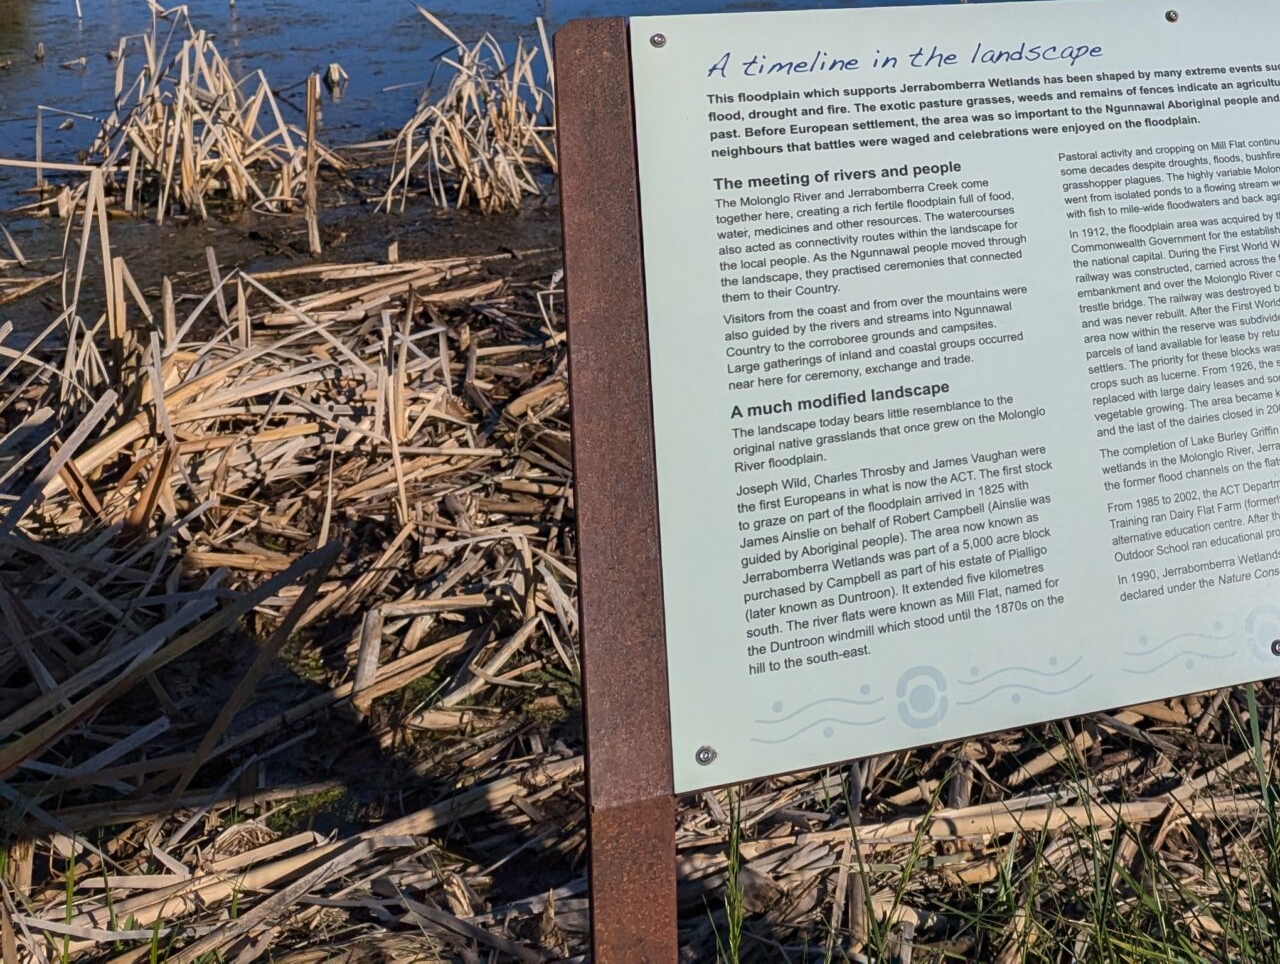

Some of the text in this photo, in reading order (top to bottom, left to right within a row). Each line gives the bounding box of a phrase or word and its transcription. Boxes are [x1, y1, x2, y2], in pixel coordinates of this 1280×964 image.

[706, 41, 1104, 79] A timeline in the landscape
[706, 93, 735, 104] This
[737, 89, 800, 103] floodplain
[803, 87, 840, 99] which
[843, 85, 897, 98] supports
[900, 80, 987, 94] Jerrabomberra
[987, 75, 1041, 88] Wetlands
[1042, 74, 1064, 85] has
[1065, 73, 1094, 84] been
[1095, 69, 1136, 83] shaped
[1137, 69, 1151, 81] by
[1153, 69, 1183, 79] many
[1184, 66, 1227, 77] extreme
[1228, 63, 1264, 74] events
[711, 115, 1201, 159] neighbours that battles were waged and celebrations were enjoyed on the floodplain.
[712, 161, 962, 190] The meeting of rivers and people
[1063, 194, 1088, 205] went
[1089, 193, 1112, 203] from
[1114, 188, 1151, 201] isolated
[1153, 186, 1183, 200] ponds
[1183, 186, 1194, 195] to
[1195, 186, 1203, 194] a
[1203, 182, 1237, 193] flowing
[1238, 180, 1270, 190] stream
[714, 179, 989, 208] The Molonglo River and Jerrabomberra Creek come
[715, 190, 1015, 226] together here, creating a rich fertile floodplain full of food,
[1071, 238, 1147, 254] Commonwealth
[1148, 232, 1207, 246] Government
[1208, 231, 1221, 240] for
[1223, 229, 1239, 239] the
[727, 331, 1024, 375] Large gatherings of inland and coastal groups occurred
[729, 383, 950, 419] A much modified landscape
[733, 406, 1046, 457] original native grasslands that once grew on the Molonglo
[1099, 448, 1120, 459] The
[1122, 440, 1177, 456] completion
[1178, 437, 1188, 448] of
[1190, 434, 1215, 446] Lake
[1216, 430, 1248, 443] Burley
[1250, 425, 1280, 438] Griffin
[734, 452, 827, 473] River floodplain.
[742, 527, 1051, 584] Jerrabomberra Wetlands was part of a 5,000 acre block
[1119, 584, 1165, 602] declared
[1166, 581, 1196, 594] under
[1198, 578, 1215, 589] the
[1217, 572, 1252, 585] Nature
[748, 645, 871, 675] hill to the south-east.
